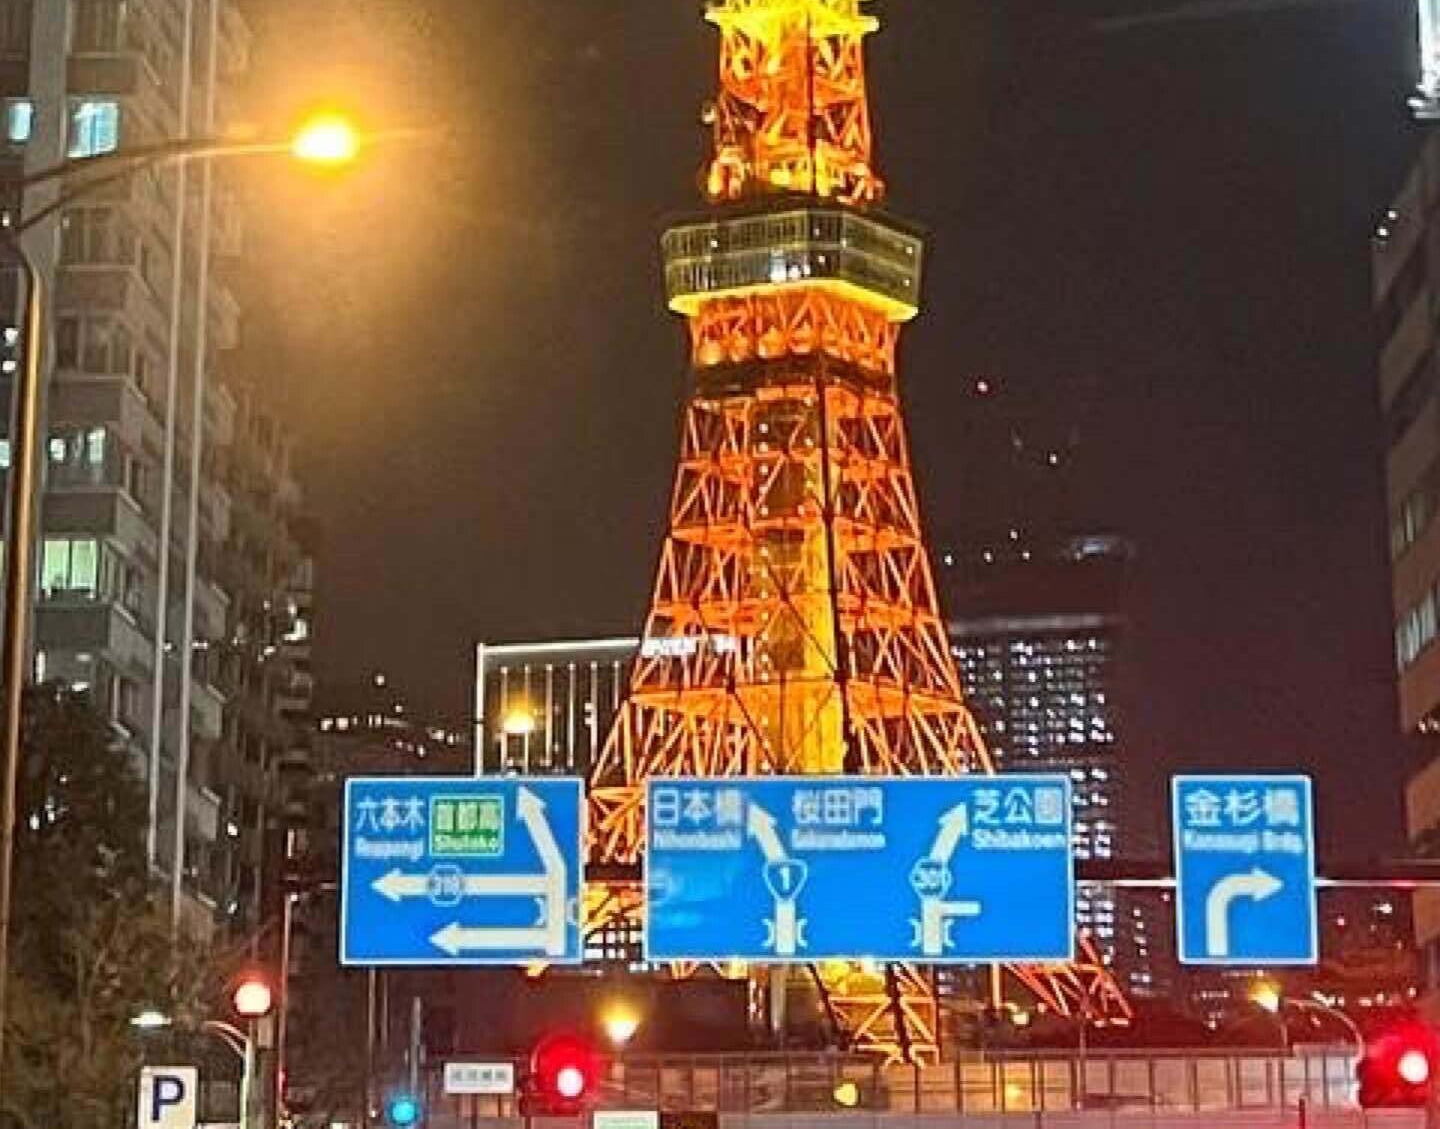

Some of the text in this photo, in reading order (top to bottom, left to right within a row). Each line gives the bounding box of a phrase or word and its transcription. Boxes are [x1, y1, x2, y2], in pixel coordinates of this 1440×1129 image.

[356, 796, 425, 832] 六本木
[654, 788, 741, 826] 日本橋
[792, 787, 883, 825] 桜田門
[972, 787, 1062, 824] 芝公園
[1184, 788, 1299, 826] 金杉橋
[780, 866, 790, 890] 1
[153, 1075, 185, 1122] P
